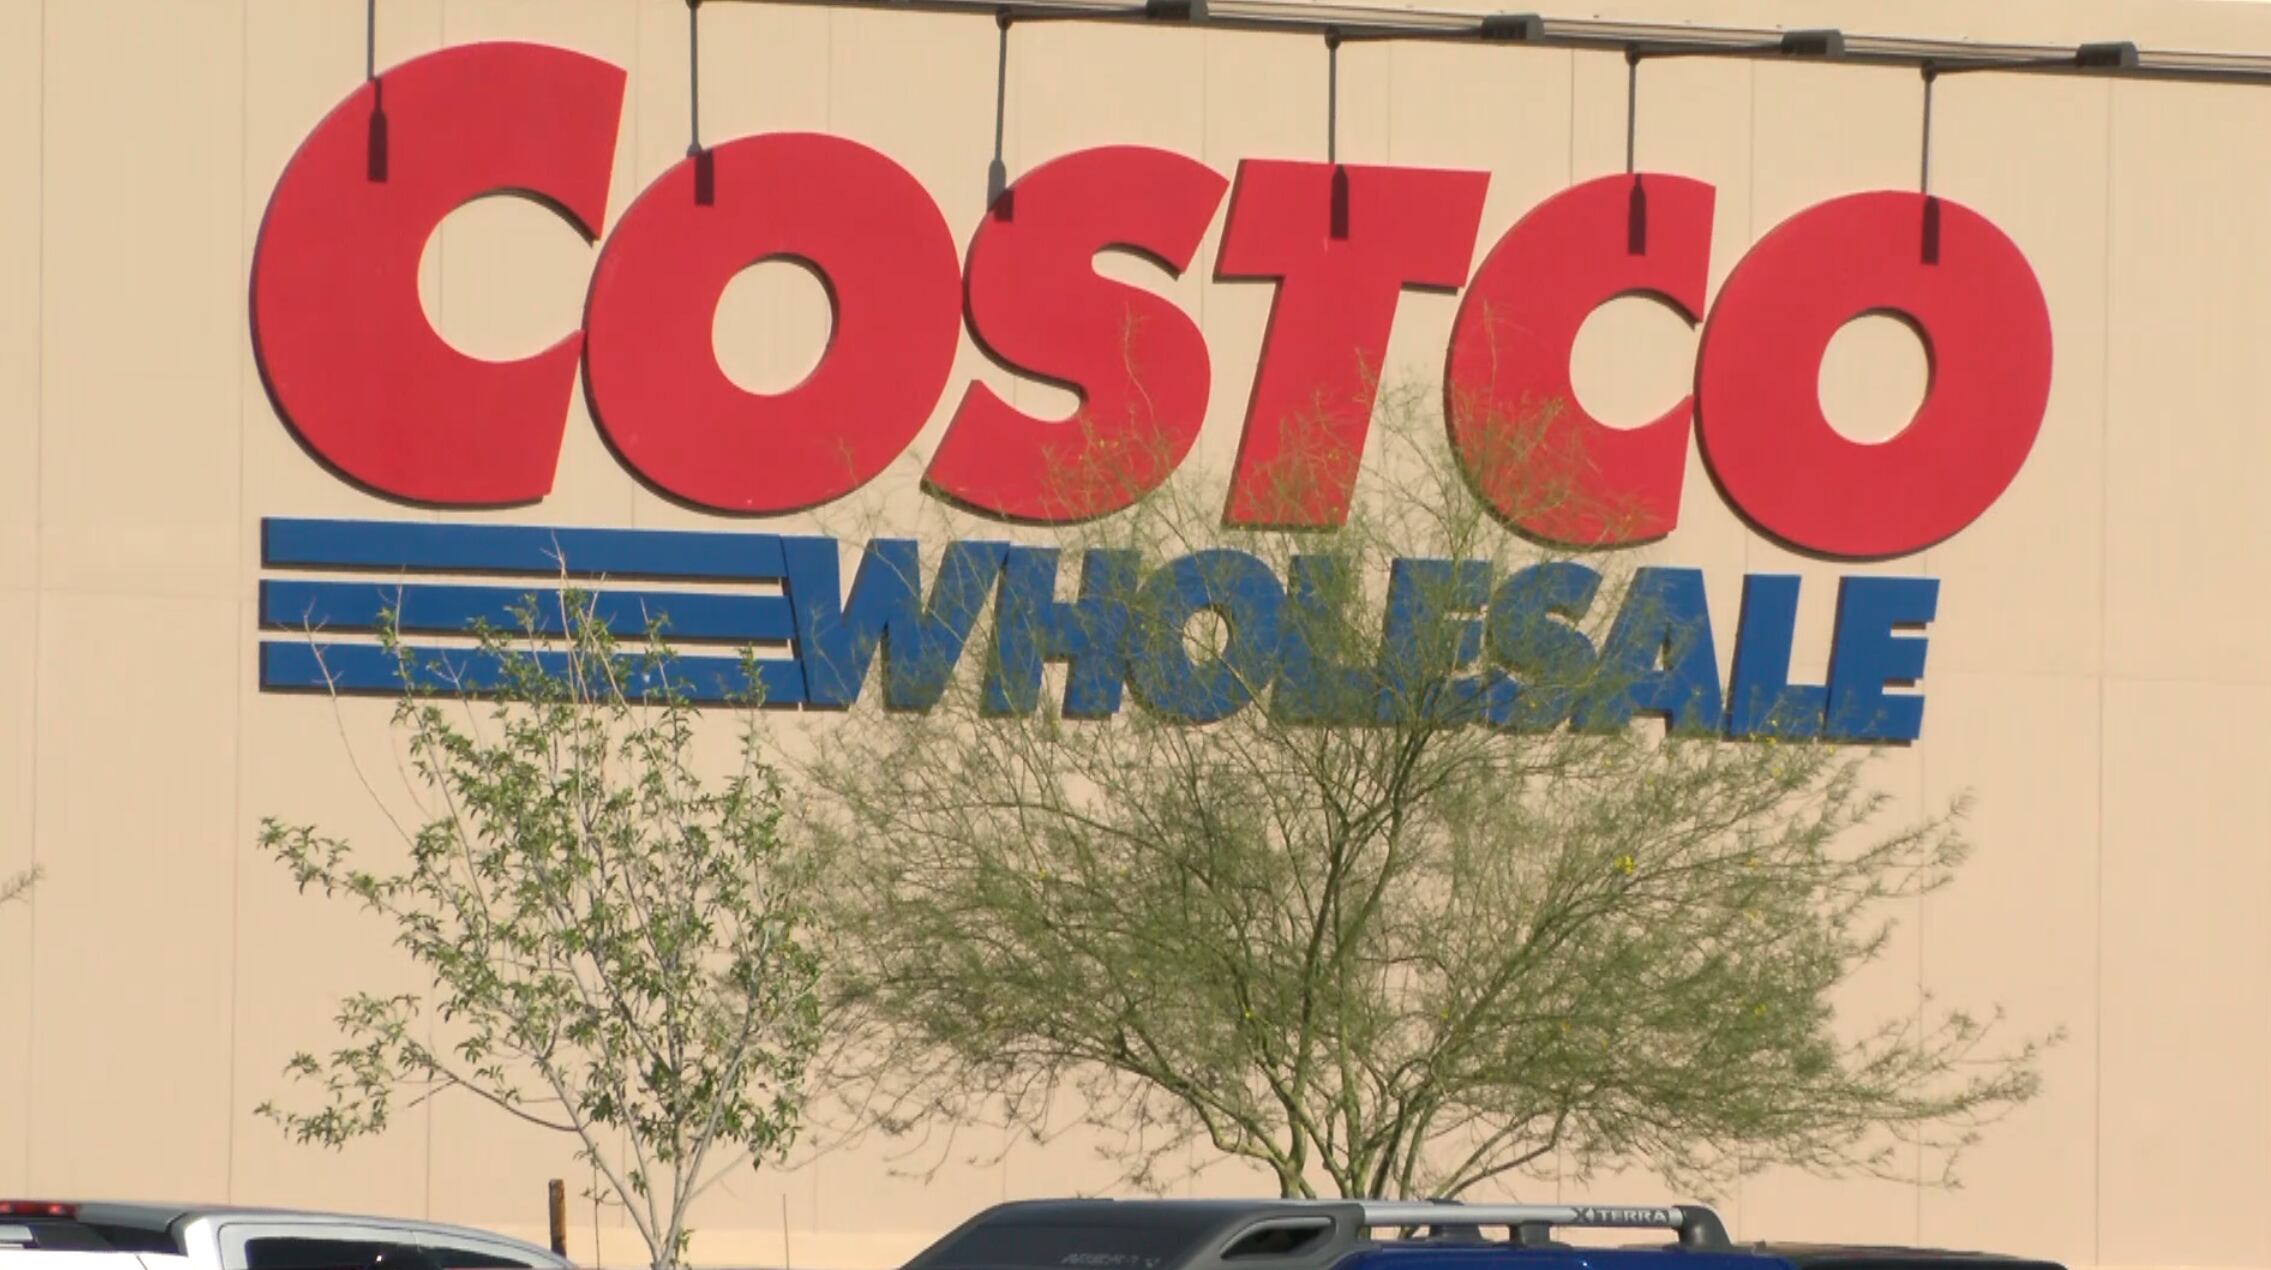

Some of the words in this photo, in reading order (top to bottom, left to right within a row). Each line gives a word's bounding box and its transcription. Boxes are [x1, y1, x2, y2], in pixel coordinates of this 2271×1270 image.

[252, 41, 2053, 556] COSTCO
[781, 535, 1940, 744] WHOLESALE
[1572, 1207, 1667, 1223] XTERRA
